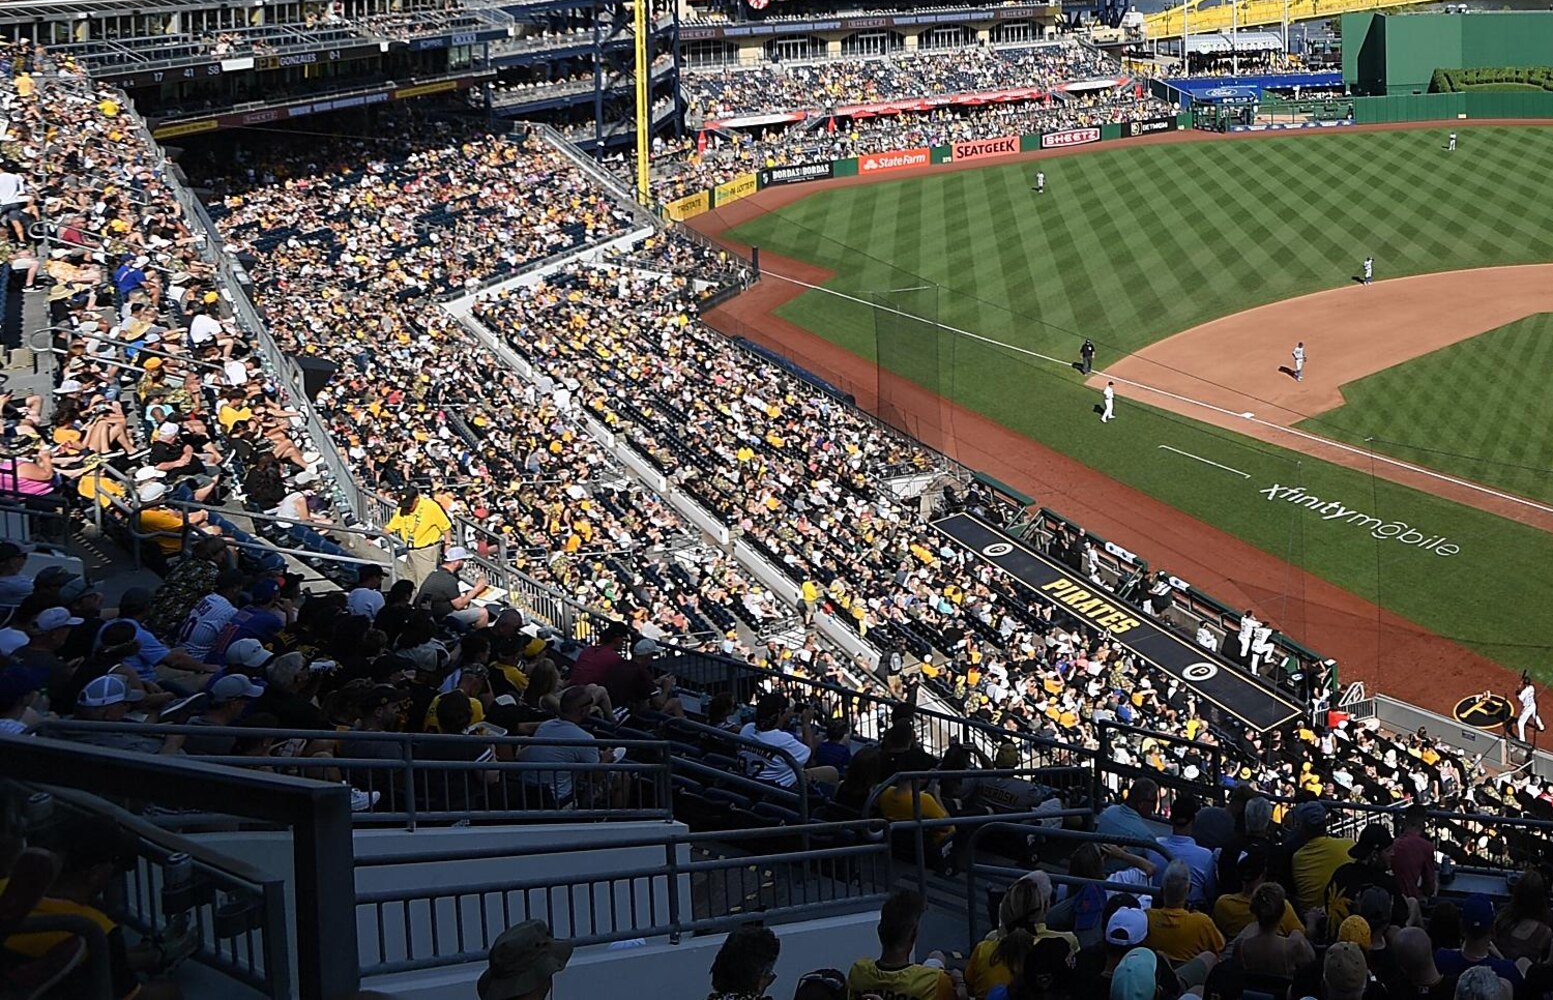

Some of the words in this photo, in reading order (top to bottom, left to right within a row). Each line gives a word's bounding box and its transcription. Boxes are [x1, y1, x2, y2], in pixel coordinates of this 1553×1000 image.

[279, 54, 317, 66] GONZALES
[329, 50, 341, 60] 0-1
[154, 72, 164, 82] 17
[184, 68, 194, 77] 41
[1045, 130, 1098, 145] SHEETZ
[956, 139, 1015, 158] SEATGEEK
[772, 167, 800, 180] BORDAS
[802, 164, 830, 176] BORDAS
[1041, 578, 1141, 635] PIRATES
